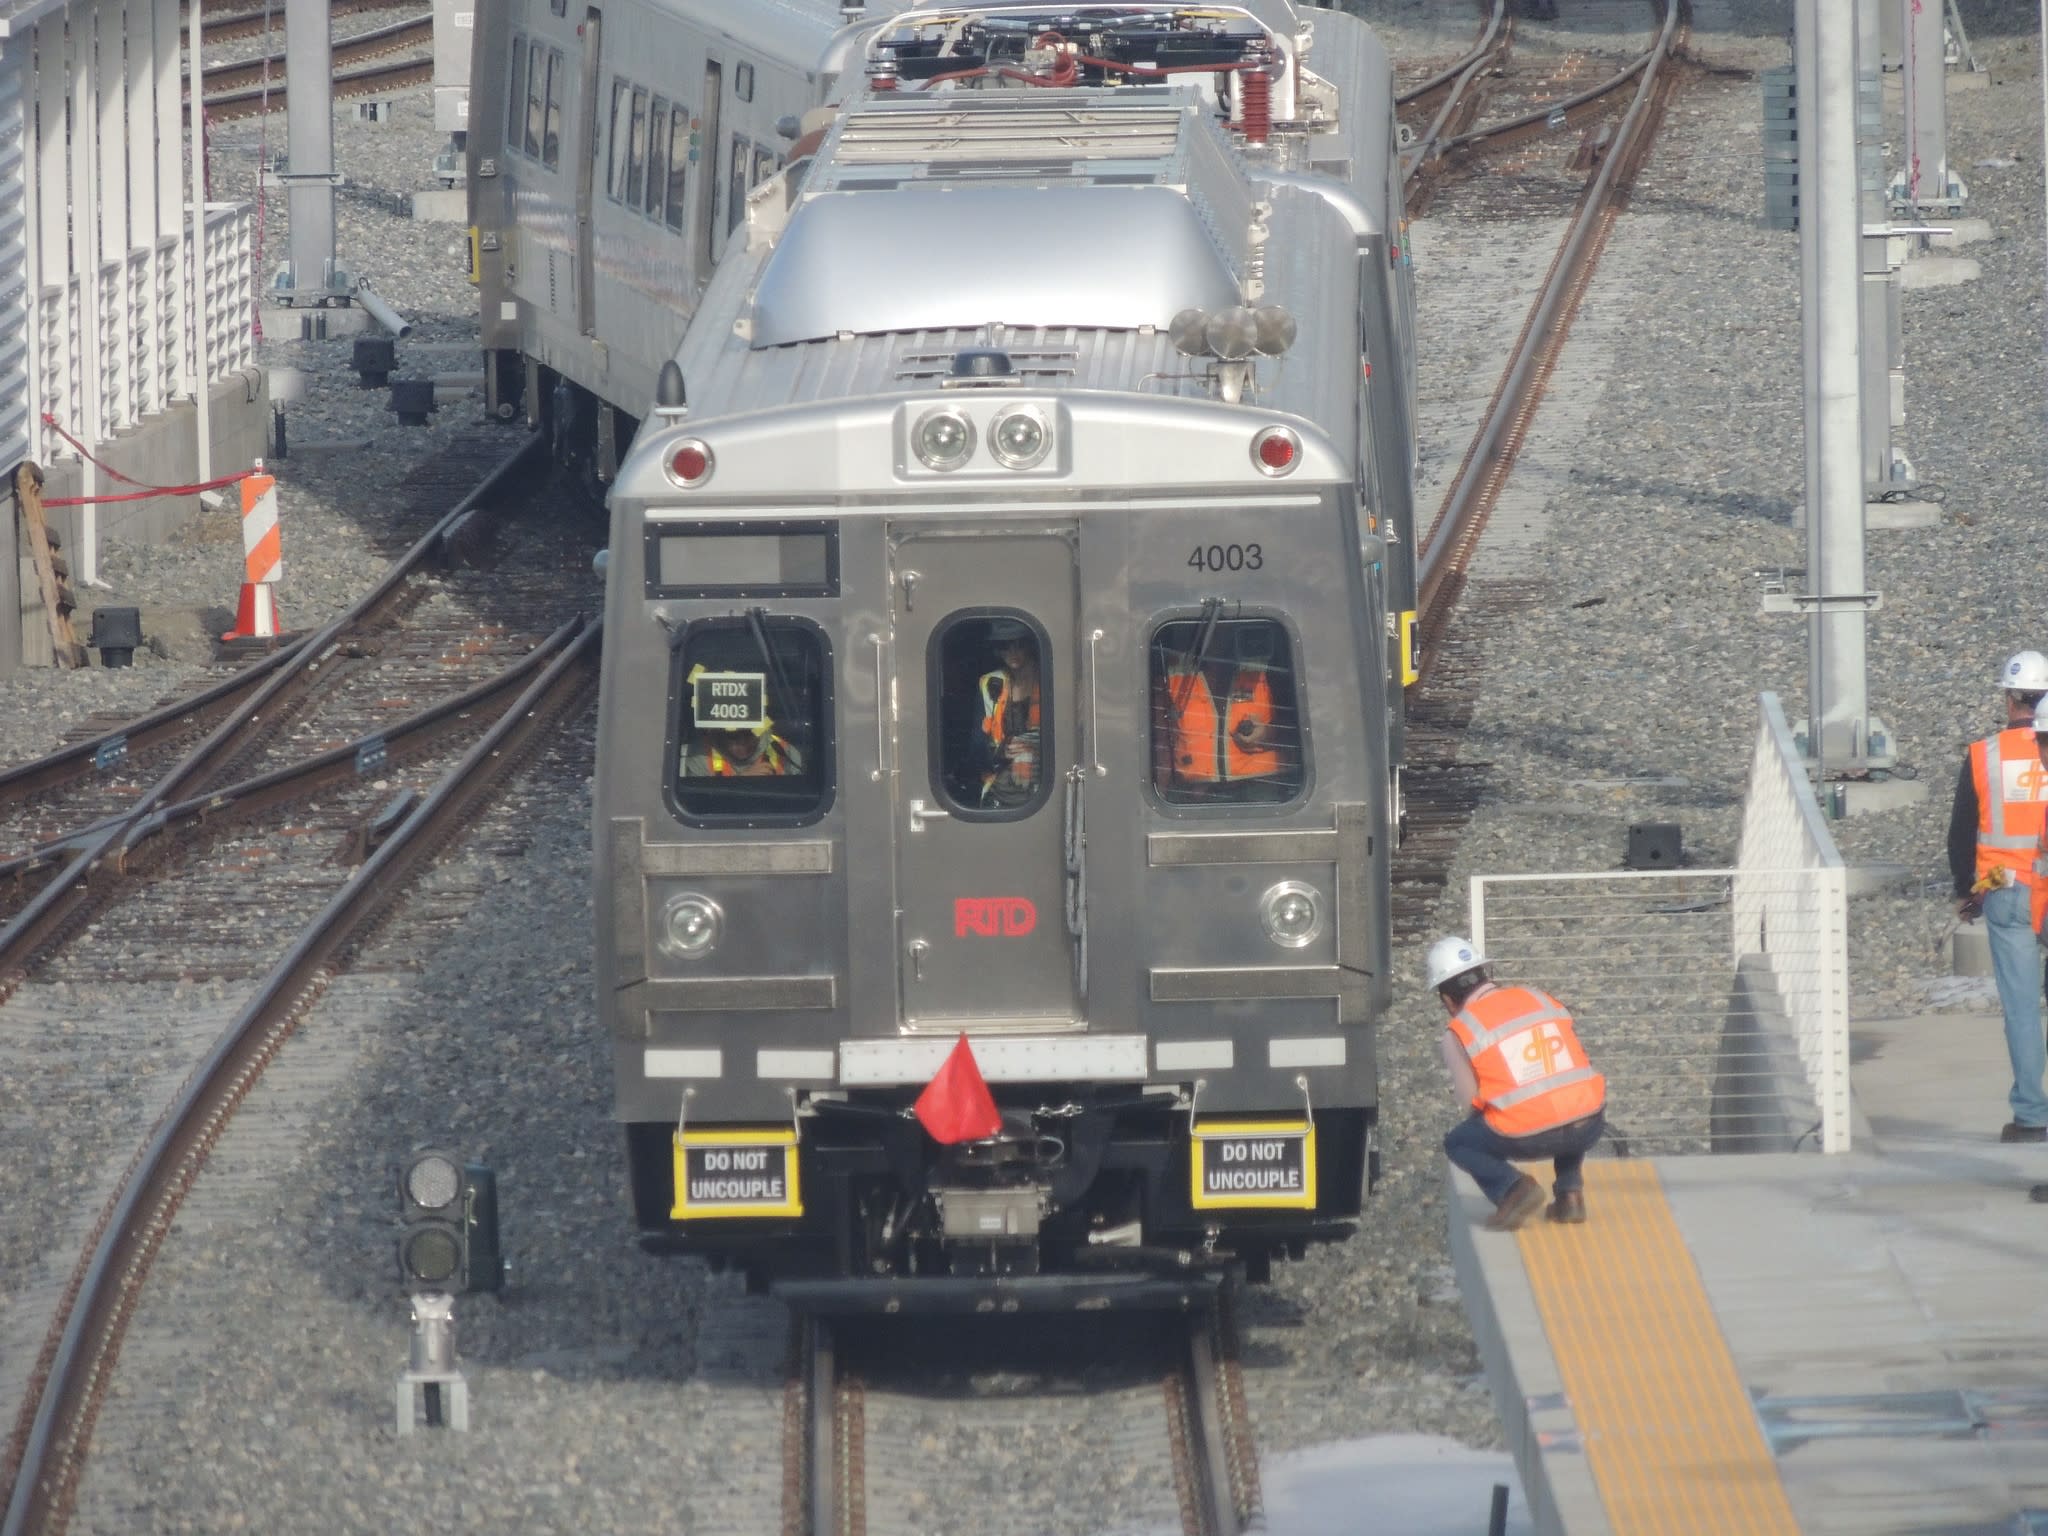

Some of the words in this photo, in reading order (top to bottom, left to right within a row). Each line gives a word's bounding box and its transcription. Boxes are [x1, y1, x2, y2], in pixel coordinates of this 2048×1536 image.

[1188, 544, 1263, 572] 4003
[711, 682, 748, 697] RTDX
[710, 704, 748, 718] 4003
[955, 897, 1036, 937] RTD
[704, 1152, 729, 1170] DO
[733, 1152, 767, 1170] NOT
[1223, 1143, 1247, 1161] DO
[1251, 1143, 1285, 1160] NOT
[1209, 1170, 1299, 1189] UNCOUPLE
[691, 1180, 782, 1199] UNCOUPLE
